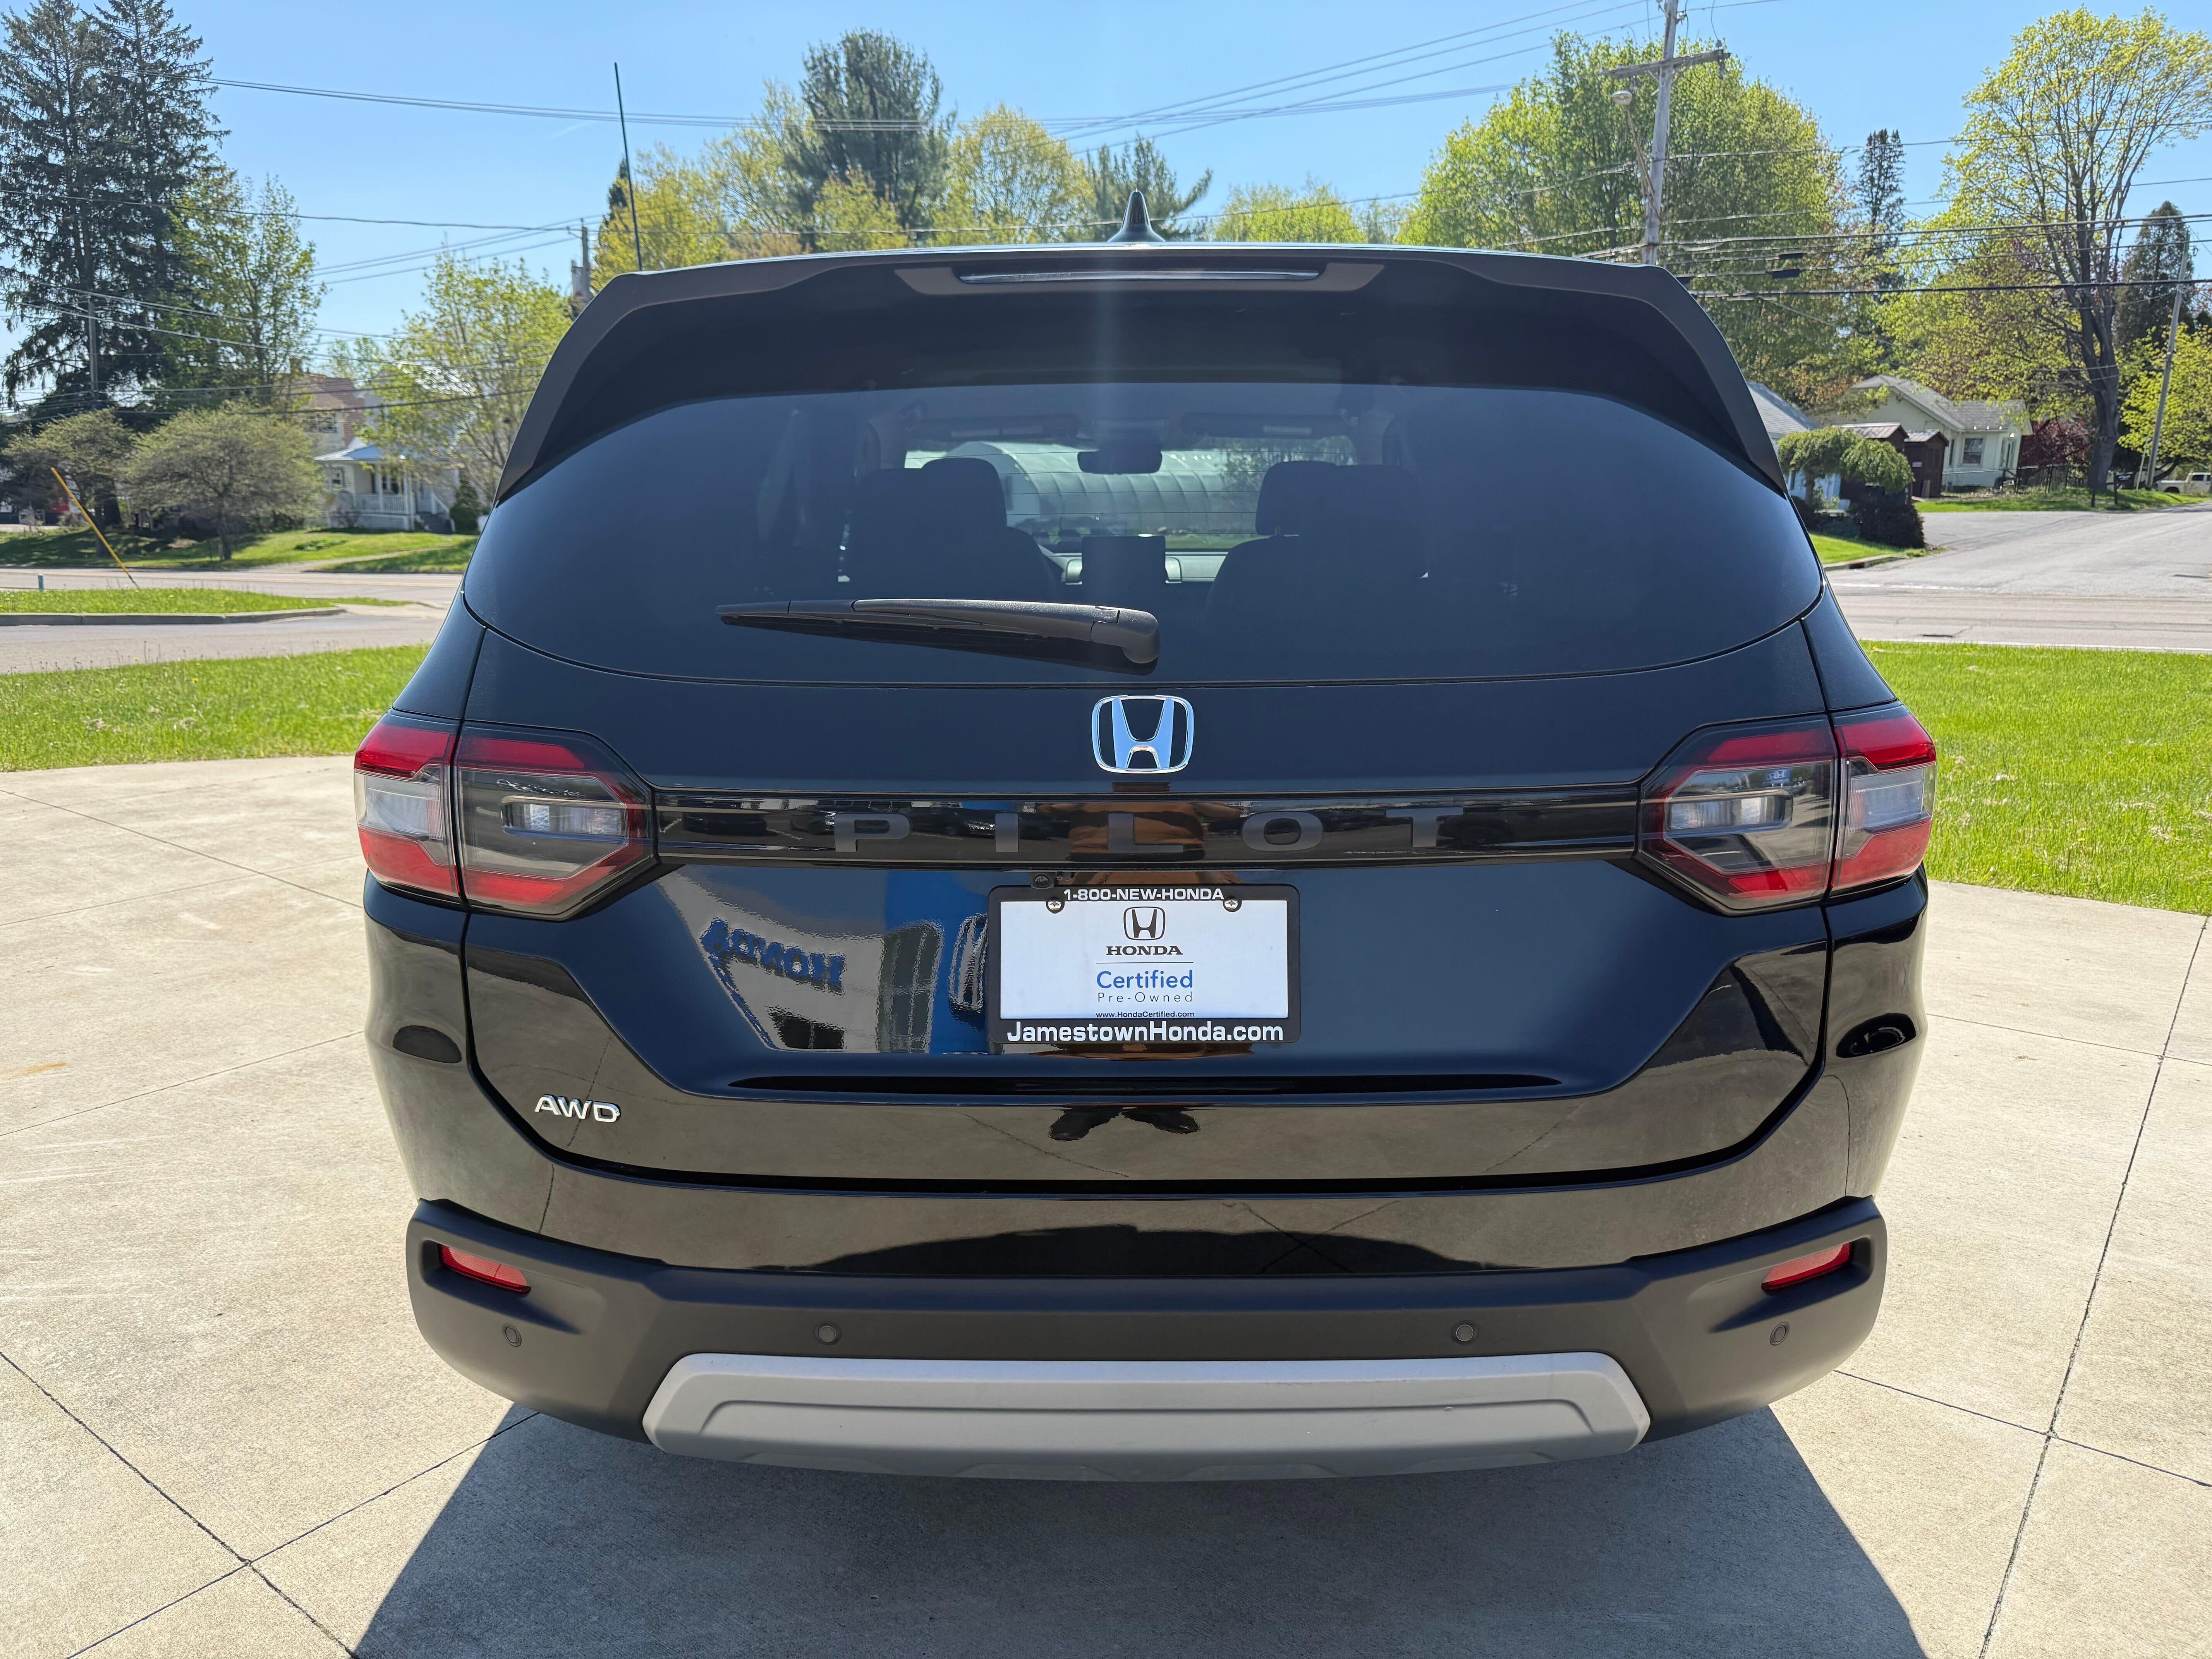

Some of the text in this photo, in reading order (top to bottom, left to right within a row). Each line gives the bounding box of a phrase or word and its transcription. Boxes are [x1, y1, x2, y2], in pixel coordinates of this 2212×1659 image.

[834, 807, 1464, 853] PILOT
[1064, 888, 1224, 900] 1-800-NEW-HONDA
[1106, 946, 1183, 955] HONDA
[1097, 969, 1193, 988] Certified
[1098, 991, 1192, 1003] Pre-Owned
[1007, 1021, 1283, 1042] JamestownHonda.com
[534, 1094, 620, 1123] AWD
